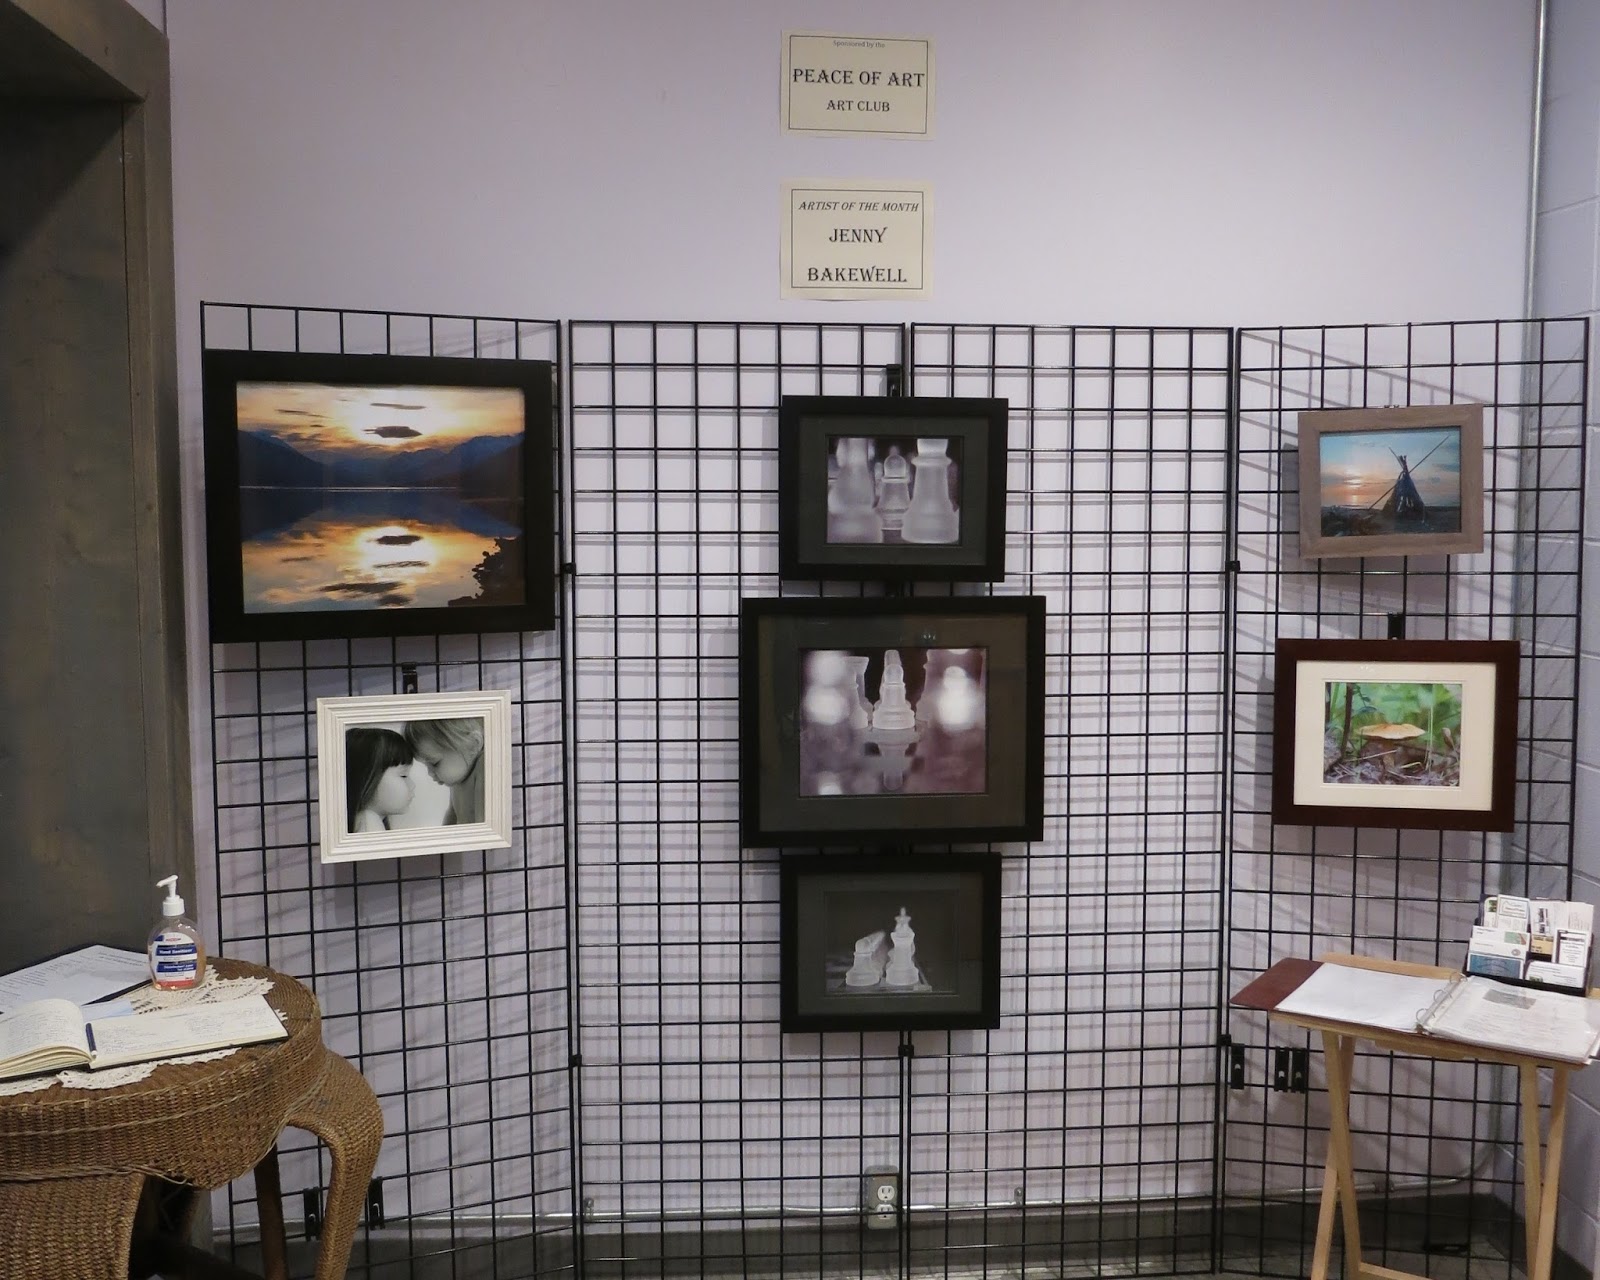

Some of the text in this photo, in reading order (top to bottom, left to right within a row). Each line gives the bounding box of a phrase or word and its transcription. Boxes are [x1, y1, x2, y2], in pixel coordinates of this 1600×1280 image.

[833, 40, 866, 48] Sponsored
[866, 41, 874, 49] by
[792, 68, 925, 88] PEACE OF ART
[826, 100, 890, 112] ART CLUB
[798, 201, 919, 212] ARTIST OF THE MONTH
[828, 226, 888, 243] JENNY
[807, 265, 907, 283] BAKEWELL
